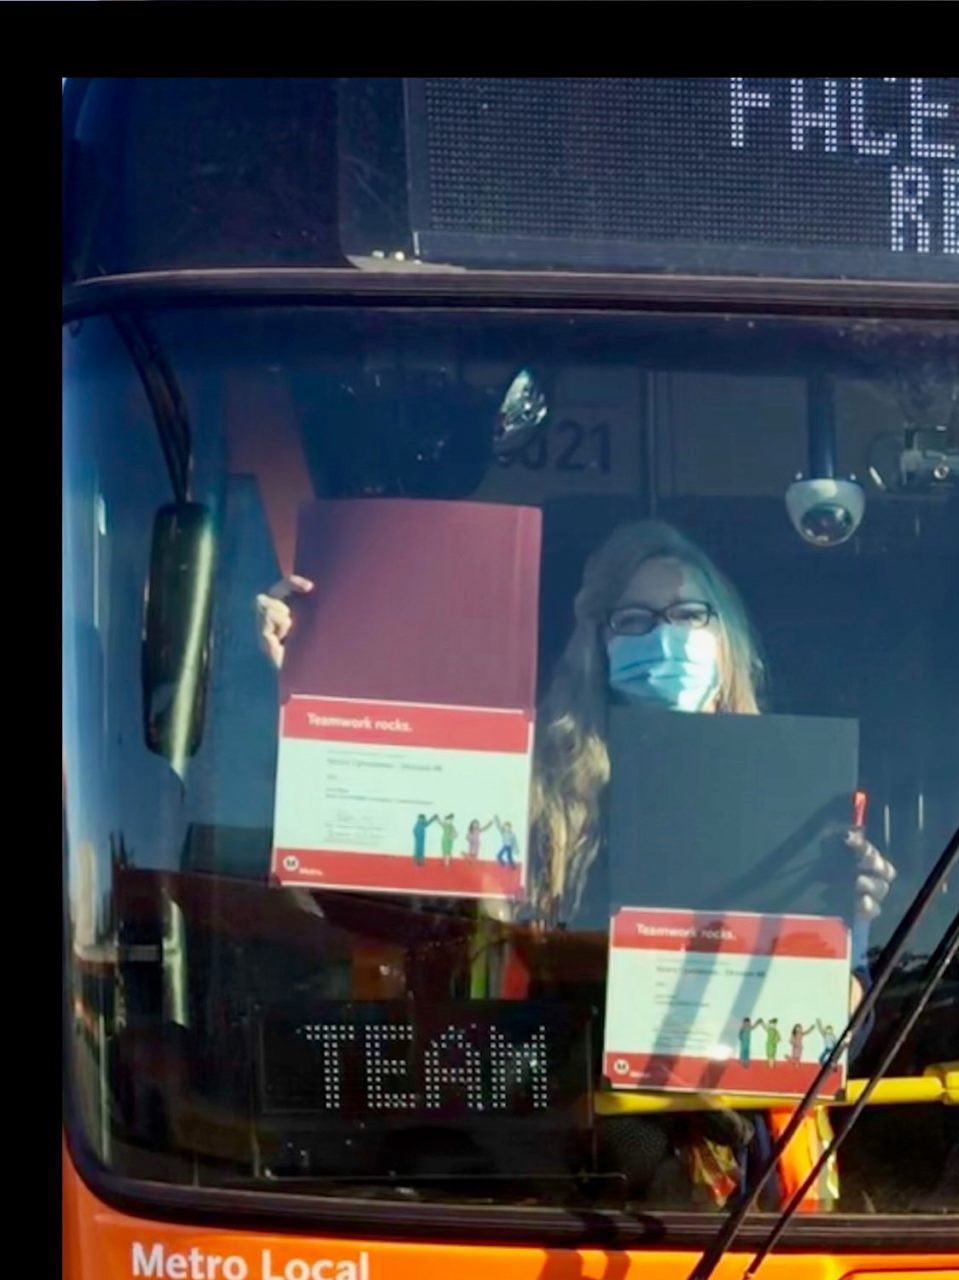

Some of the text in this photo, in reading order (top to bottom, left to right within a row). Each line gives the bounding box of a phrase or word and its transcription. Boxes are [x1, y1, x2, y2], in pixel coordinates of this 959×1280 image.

[306, 712, 413, 733] Teamwork rocks.
[635, 923, 737, 941] Teamwork rocks.
[305, 1024, 549, 1109] TEAM
